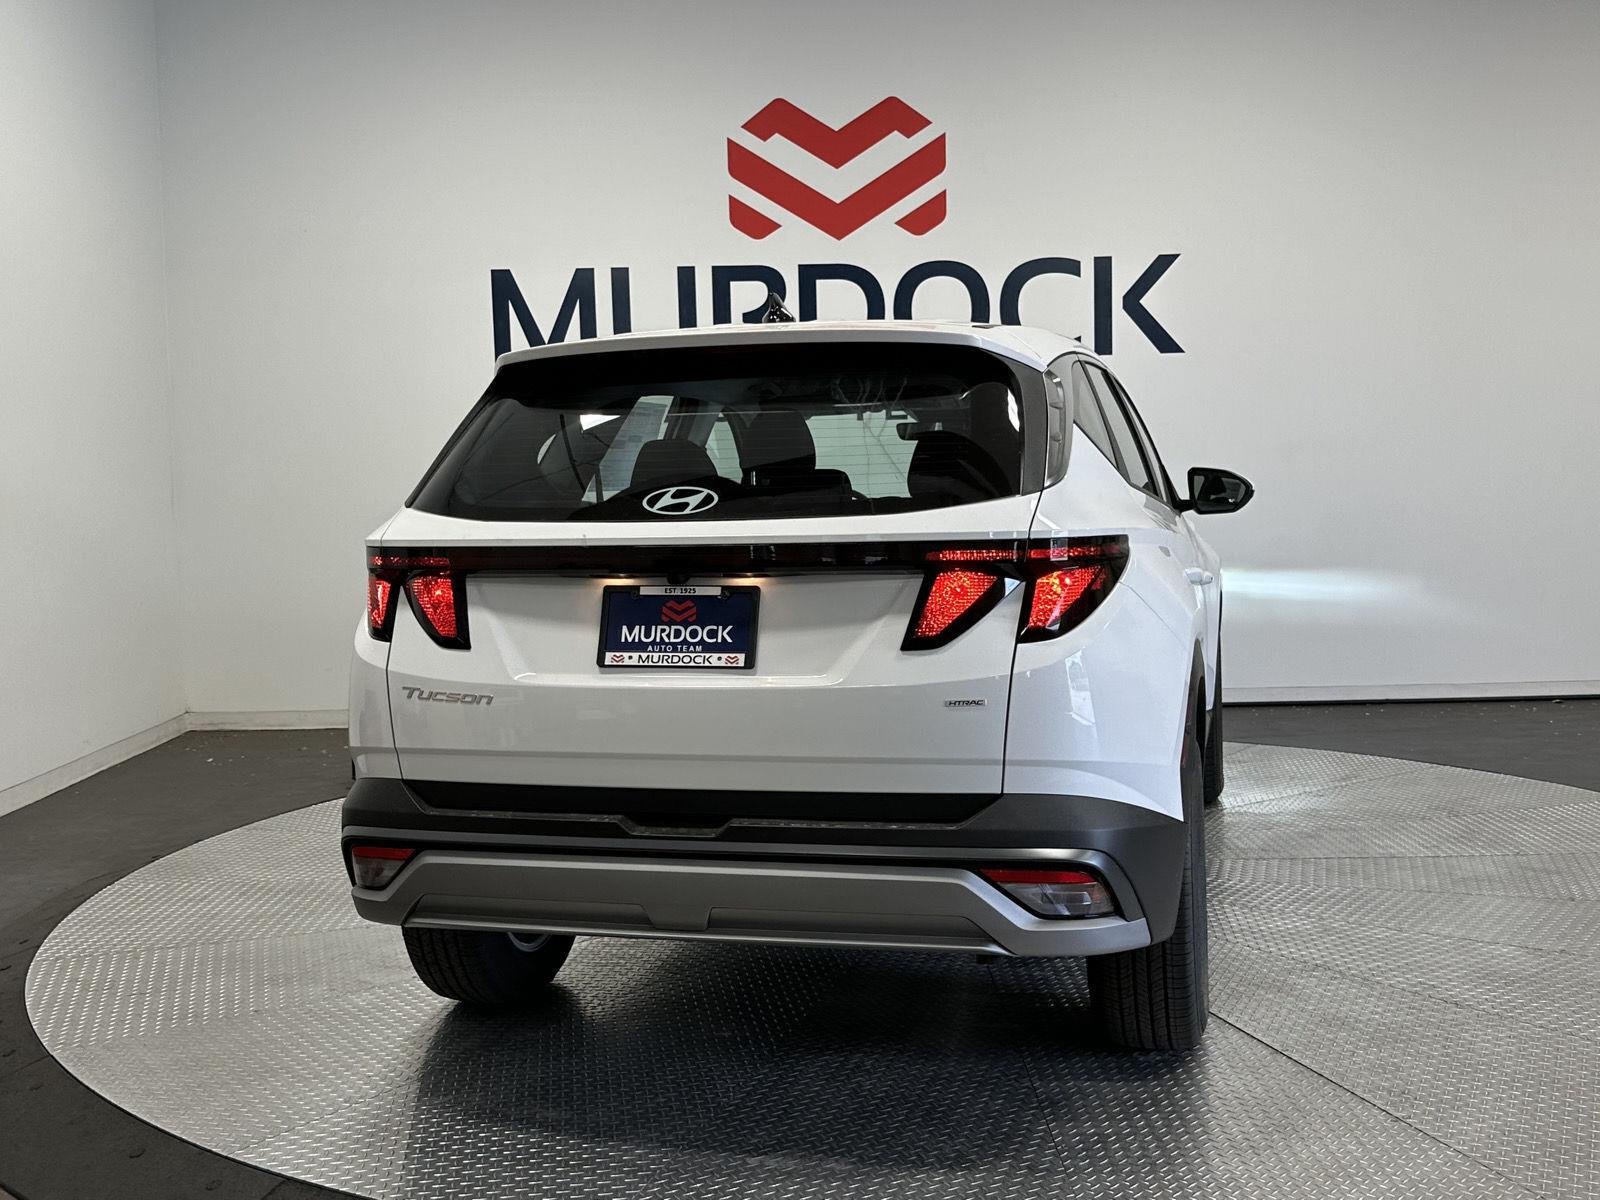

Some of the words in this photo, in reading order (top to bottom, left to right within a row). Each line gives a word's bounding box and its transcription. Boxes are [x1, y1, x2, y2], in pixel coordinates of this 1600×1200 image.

[490, 253, 1186, 358] MURDOCK
[664, 587, 679, 595] EST.
[680, 587, 697, 595] 1925
[620, 625, 734, 643] MURDOCK
[637, 654, 713, 665] MURDOCK
